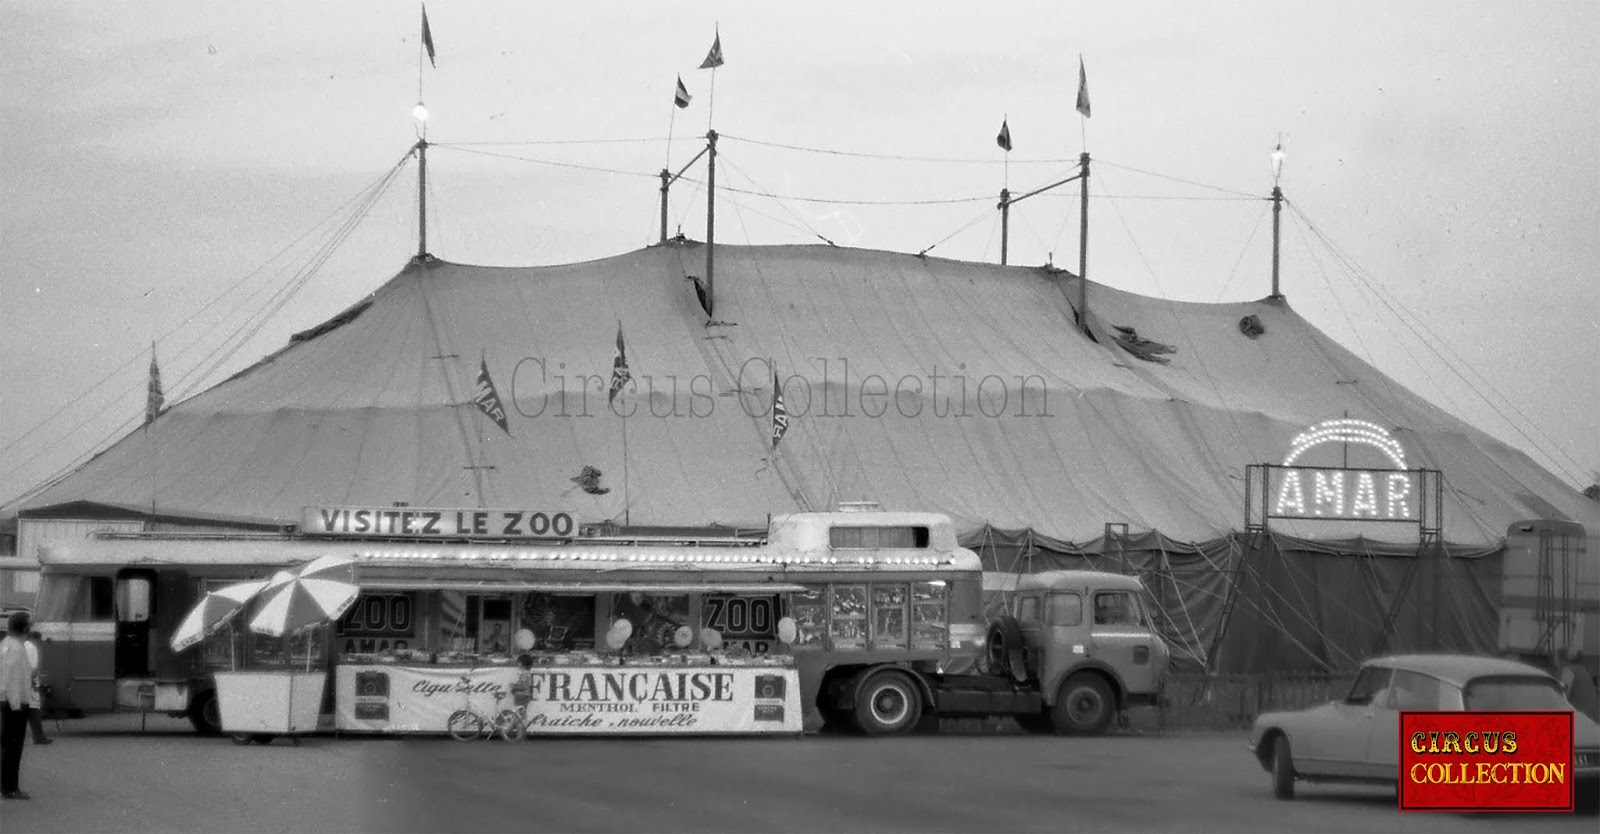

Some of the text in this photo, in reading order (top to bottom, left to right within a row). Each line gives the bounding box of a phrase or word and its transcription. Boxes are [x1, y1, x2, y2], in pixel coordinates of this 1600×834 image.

[1276, 470, 1411, 518] AMAR
[320, 508, 573, 536] VISITEZ LE ZOO
[705, 597, 771, 634] ZOO
[529, 672, 734, 702] FRANÇAISE
[559, 702, 700, 713] MENTHOL FILTRE
